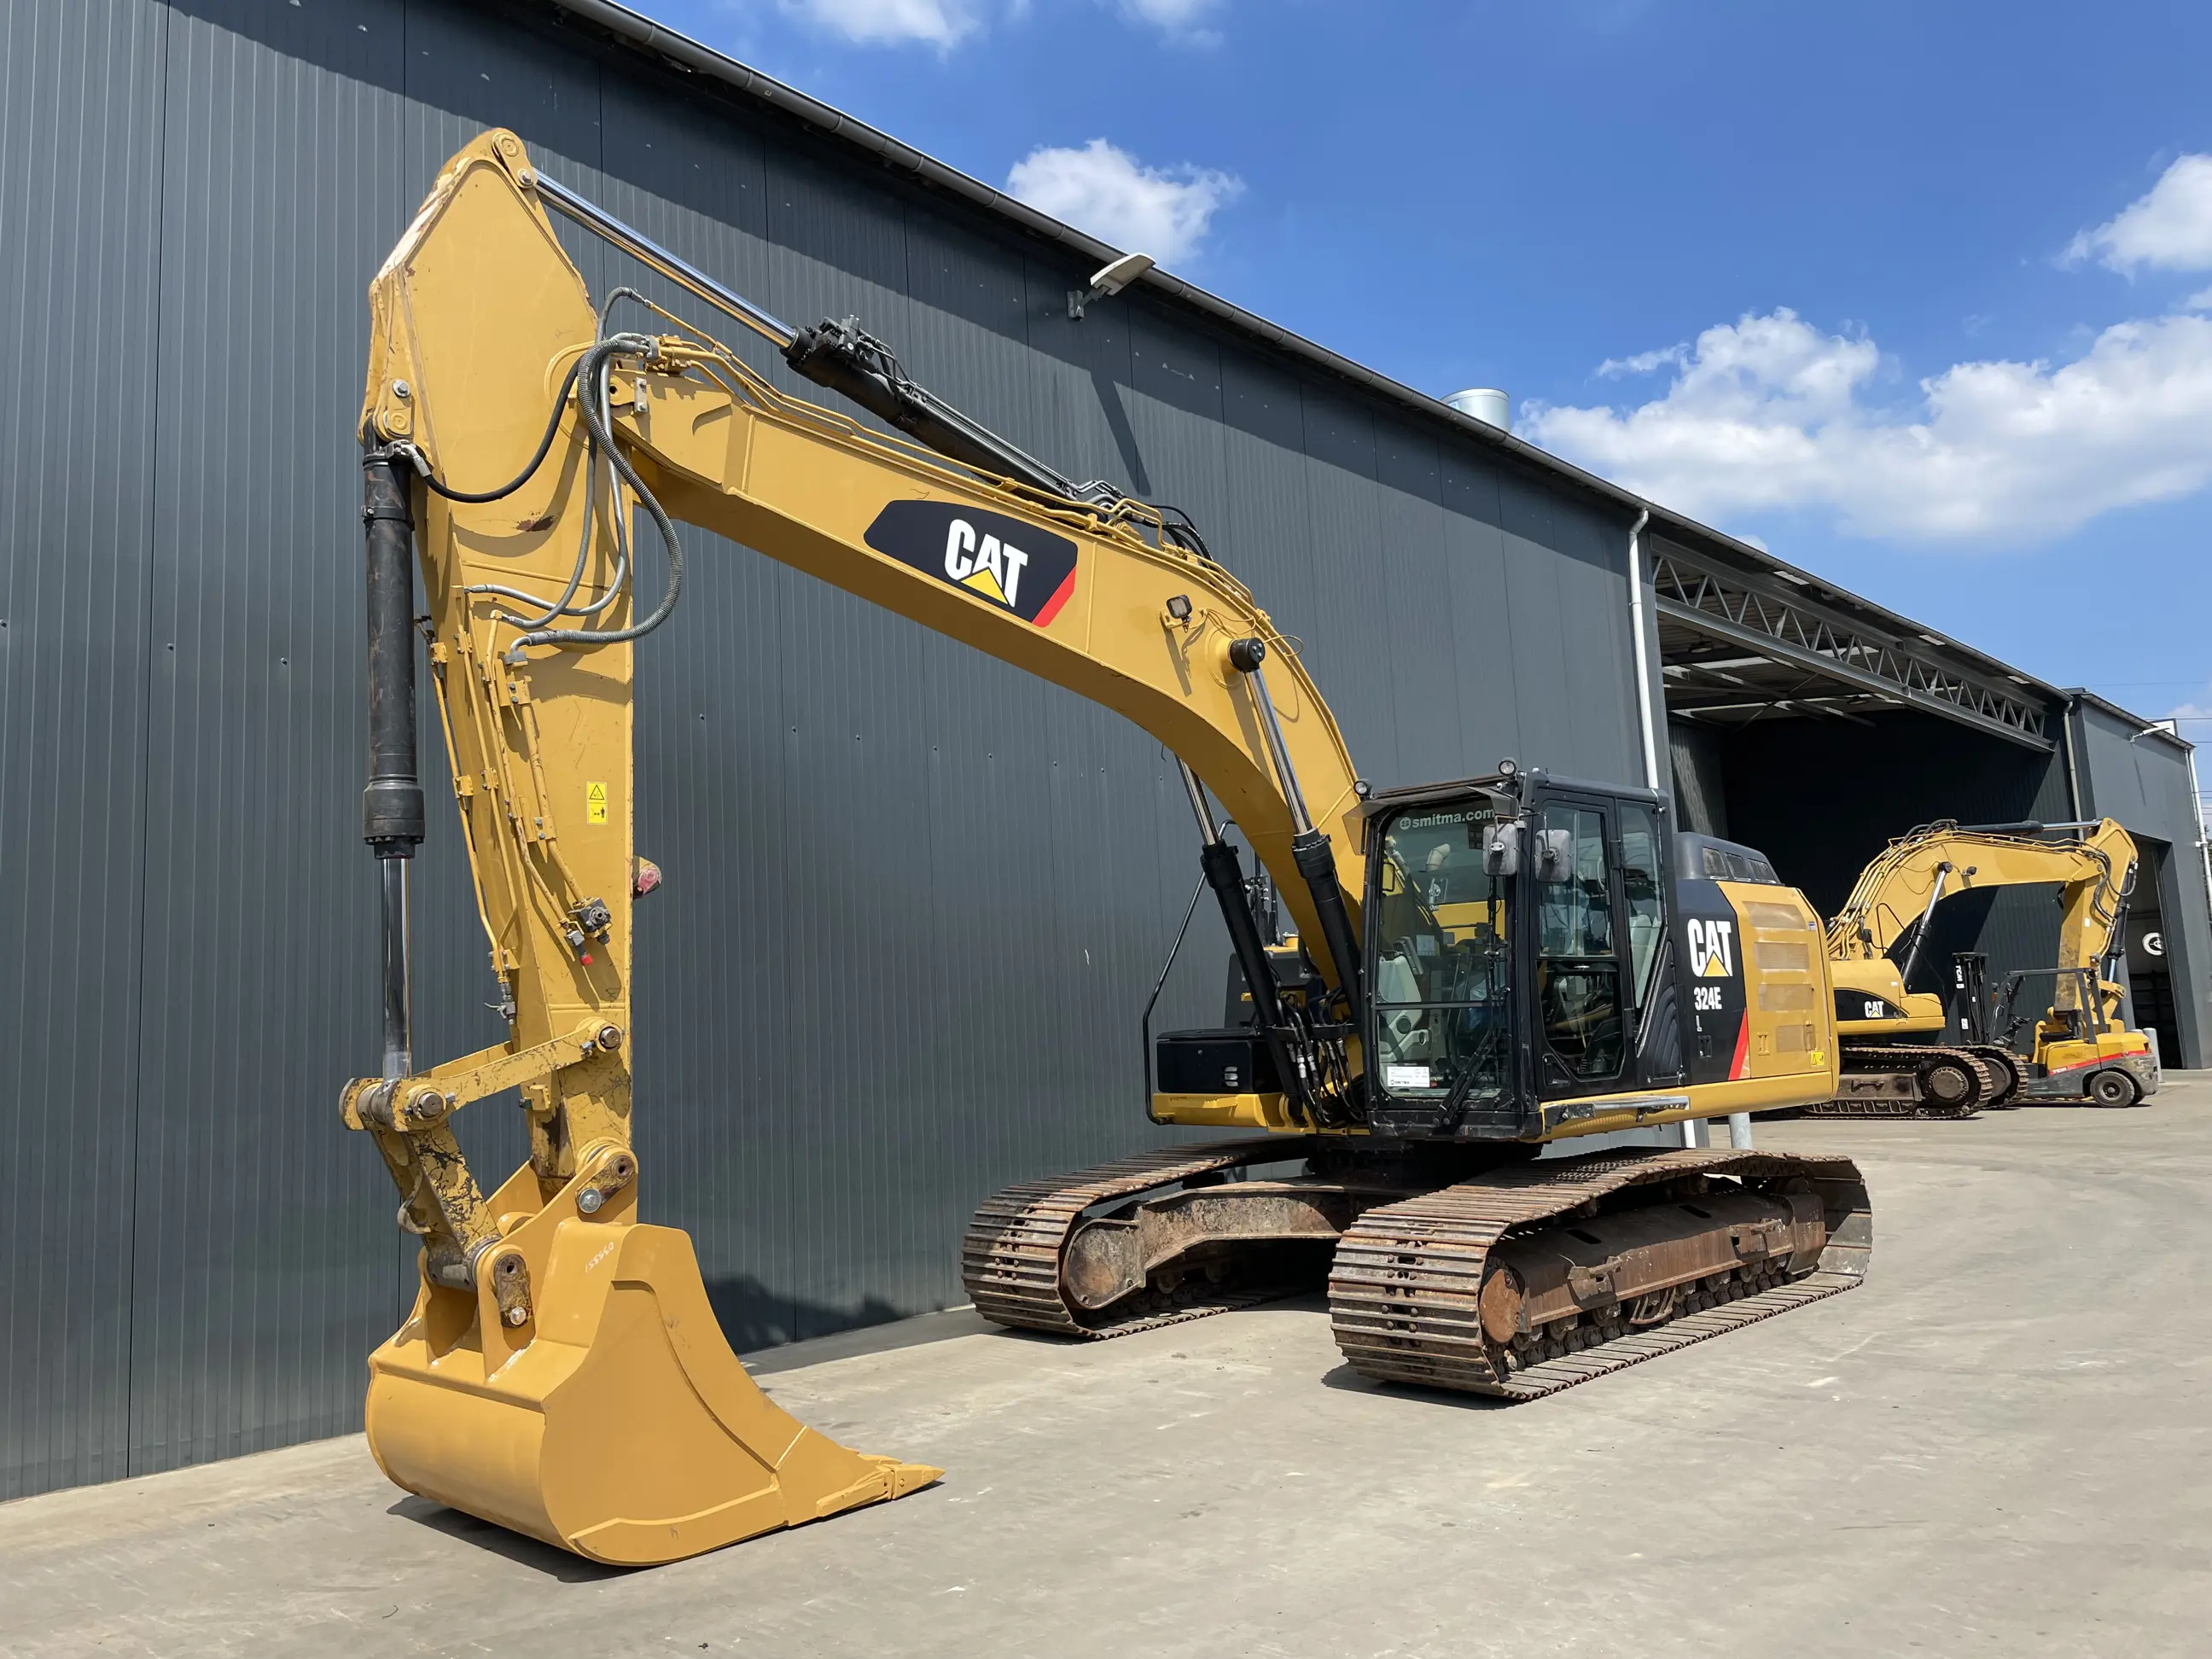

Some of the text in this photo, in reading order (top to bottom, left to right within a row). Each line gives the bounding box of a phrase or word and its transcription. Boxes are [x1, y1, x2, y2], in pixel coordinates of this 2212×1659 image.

[945, 519, 1028, 608] CAT
[1412, 808, 1495, 828] smitma.com
[1687, 918, 1732, 977] CAT
[1694, 987, 1722, 1010] 324E
[1864, 1000, 1884, 1018] CAT
[1695, 1015, 1703, 1032] L
